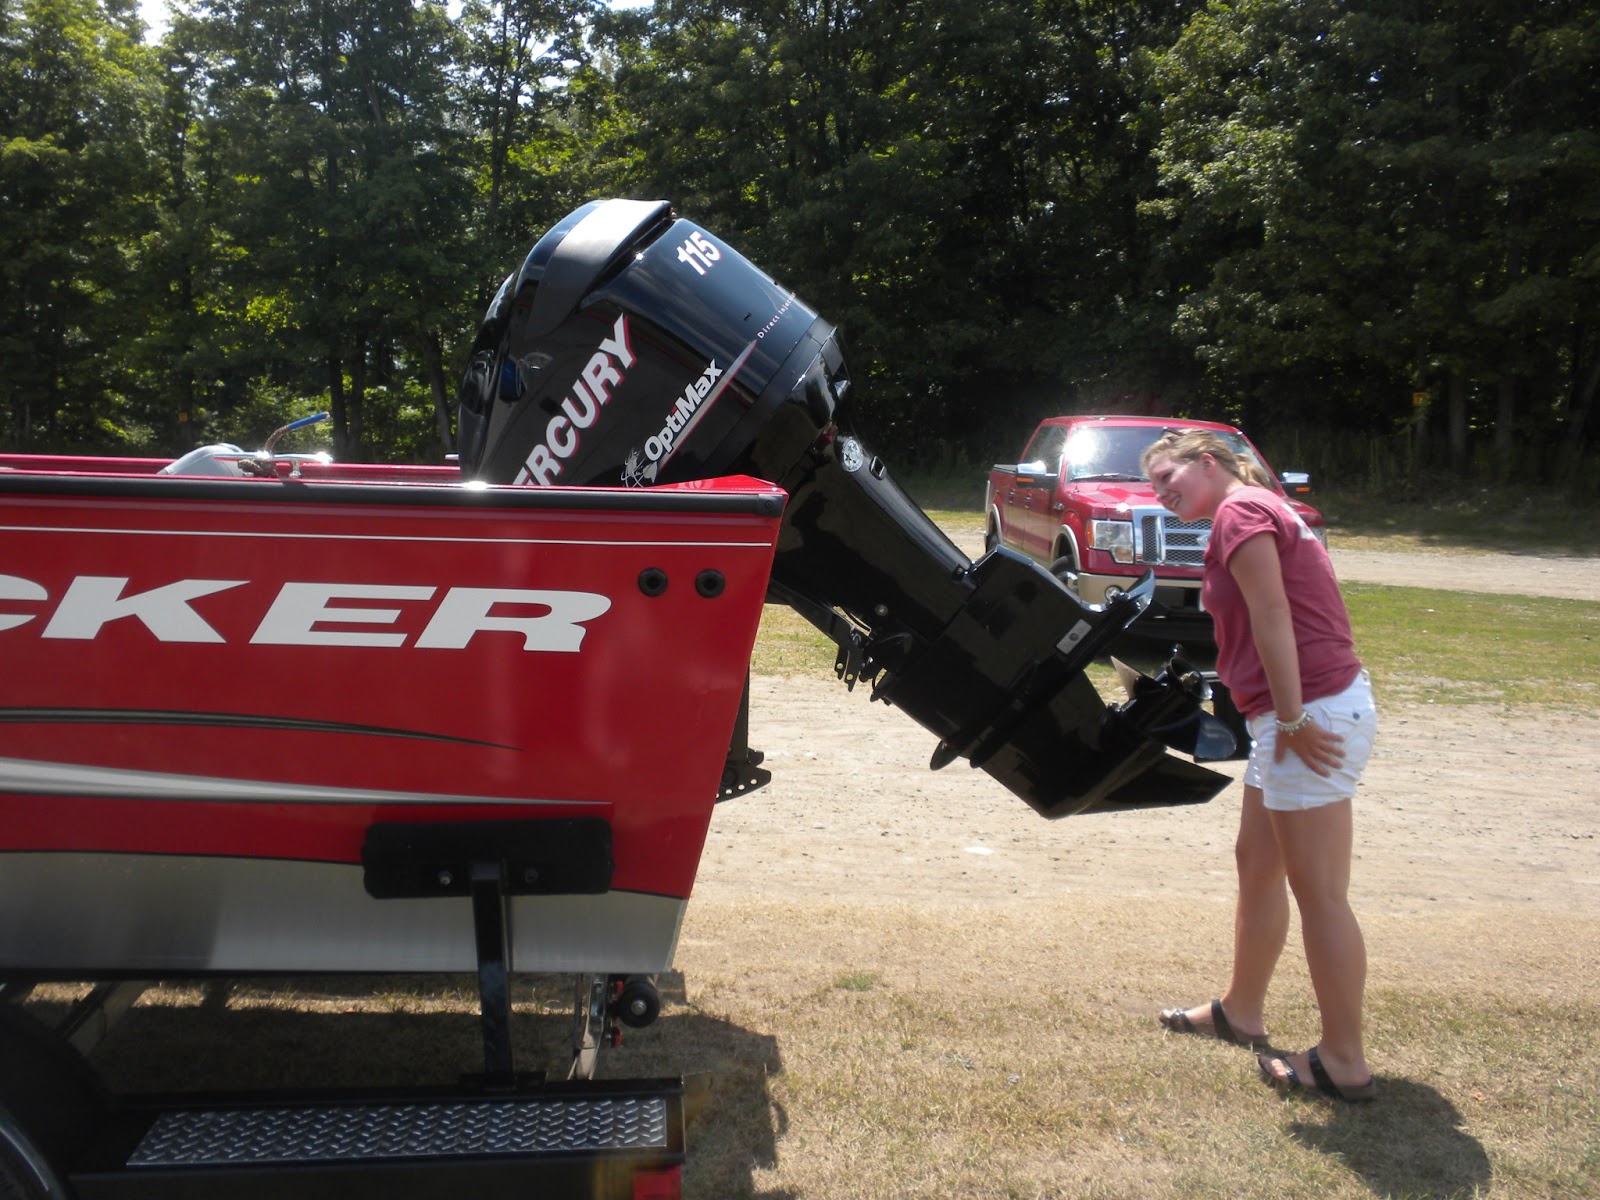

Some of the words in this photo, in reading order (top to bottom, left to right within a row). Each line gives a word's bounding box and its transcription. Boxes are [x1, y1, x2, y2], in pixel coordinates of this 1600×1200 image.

[676, 230, 721, 276] 115
[757, 315, 780, 338] Direct
[512, 313, 637, 486] RCURY
[644, 358, 723, 461] OptiMax
